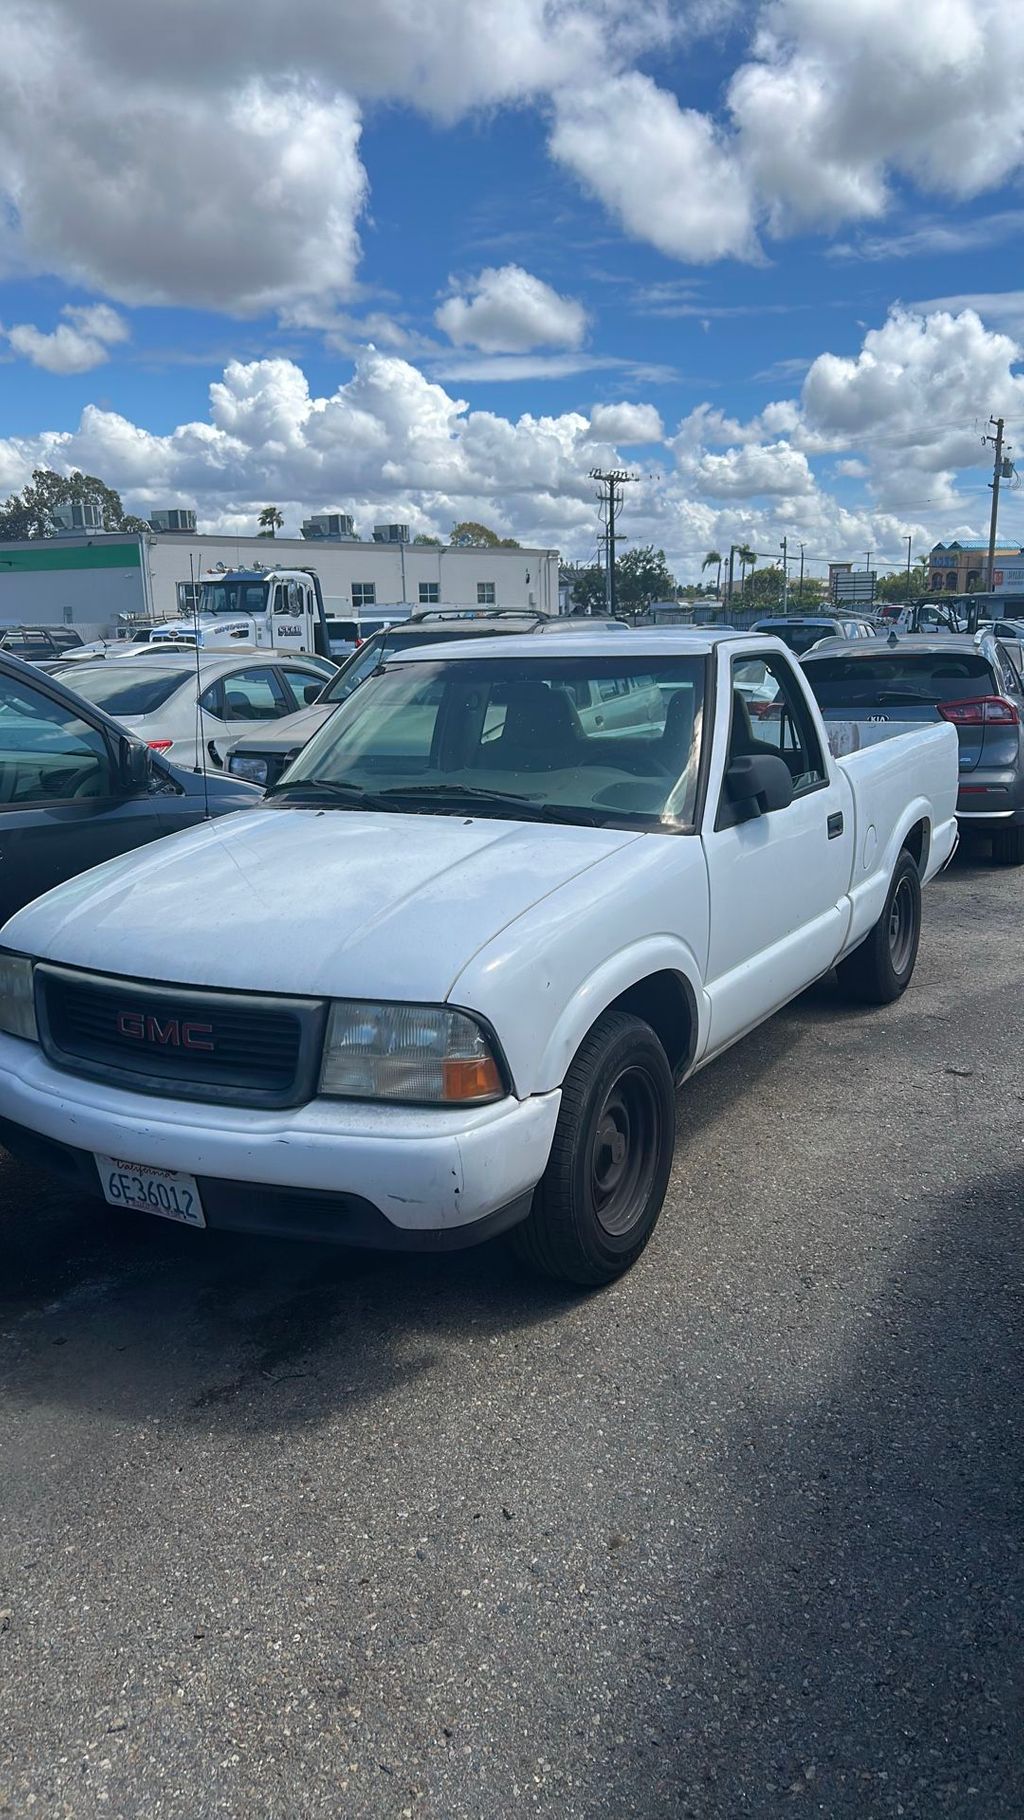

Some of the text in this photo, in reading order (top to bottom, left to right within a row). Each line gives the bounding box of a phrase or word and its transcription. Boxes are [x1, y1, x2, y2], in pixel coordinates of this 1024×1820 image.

[115, 1010, 214, 1051] GMC
[116, 1160, 172, 1178] California
[109, 1172, 198, 1219] 6E36012
